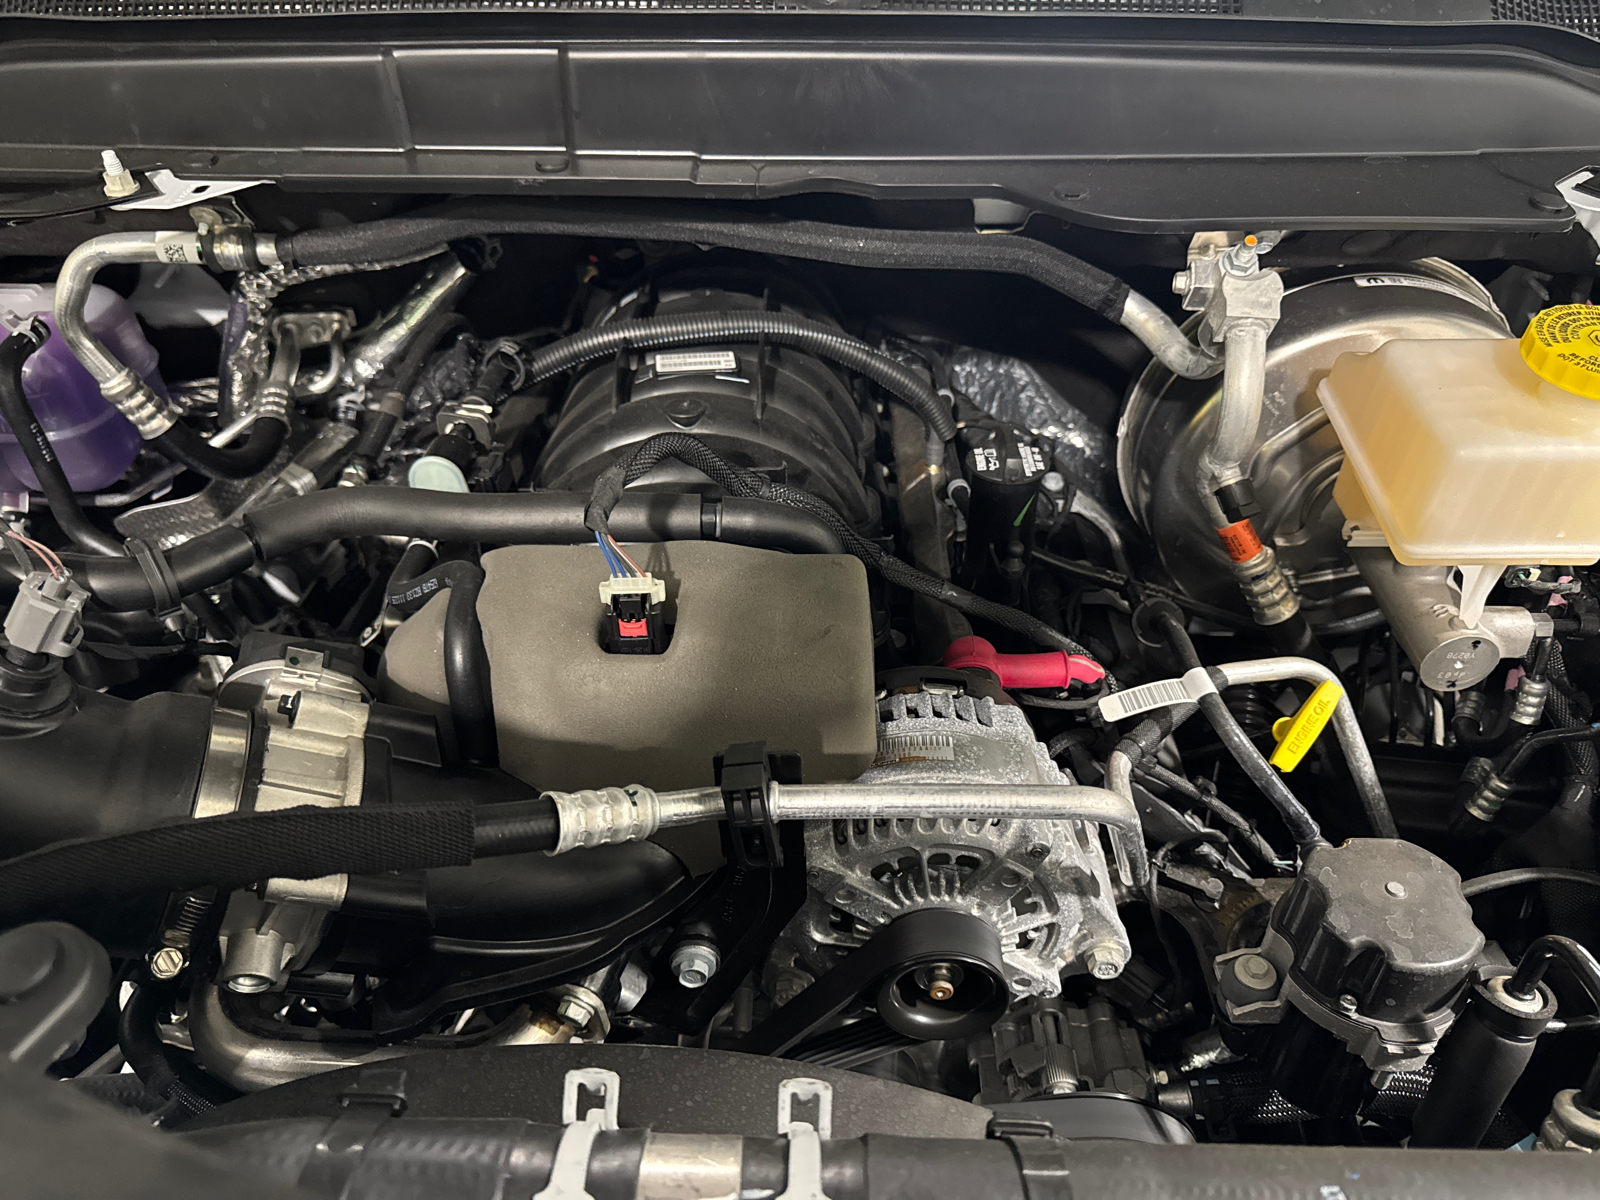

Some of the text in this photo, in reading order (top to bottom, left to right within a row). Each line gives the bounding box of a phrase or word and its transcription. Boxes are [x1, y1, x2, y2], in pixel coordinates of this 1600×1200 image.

[1557, 353, 1575, 363] DOT
[1286, 699, 1331, 755] ENGINE OIL
